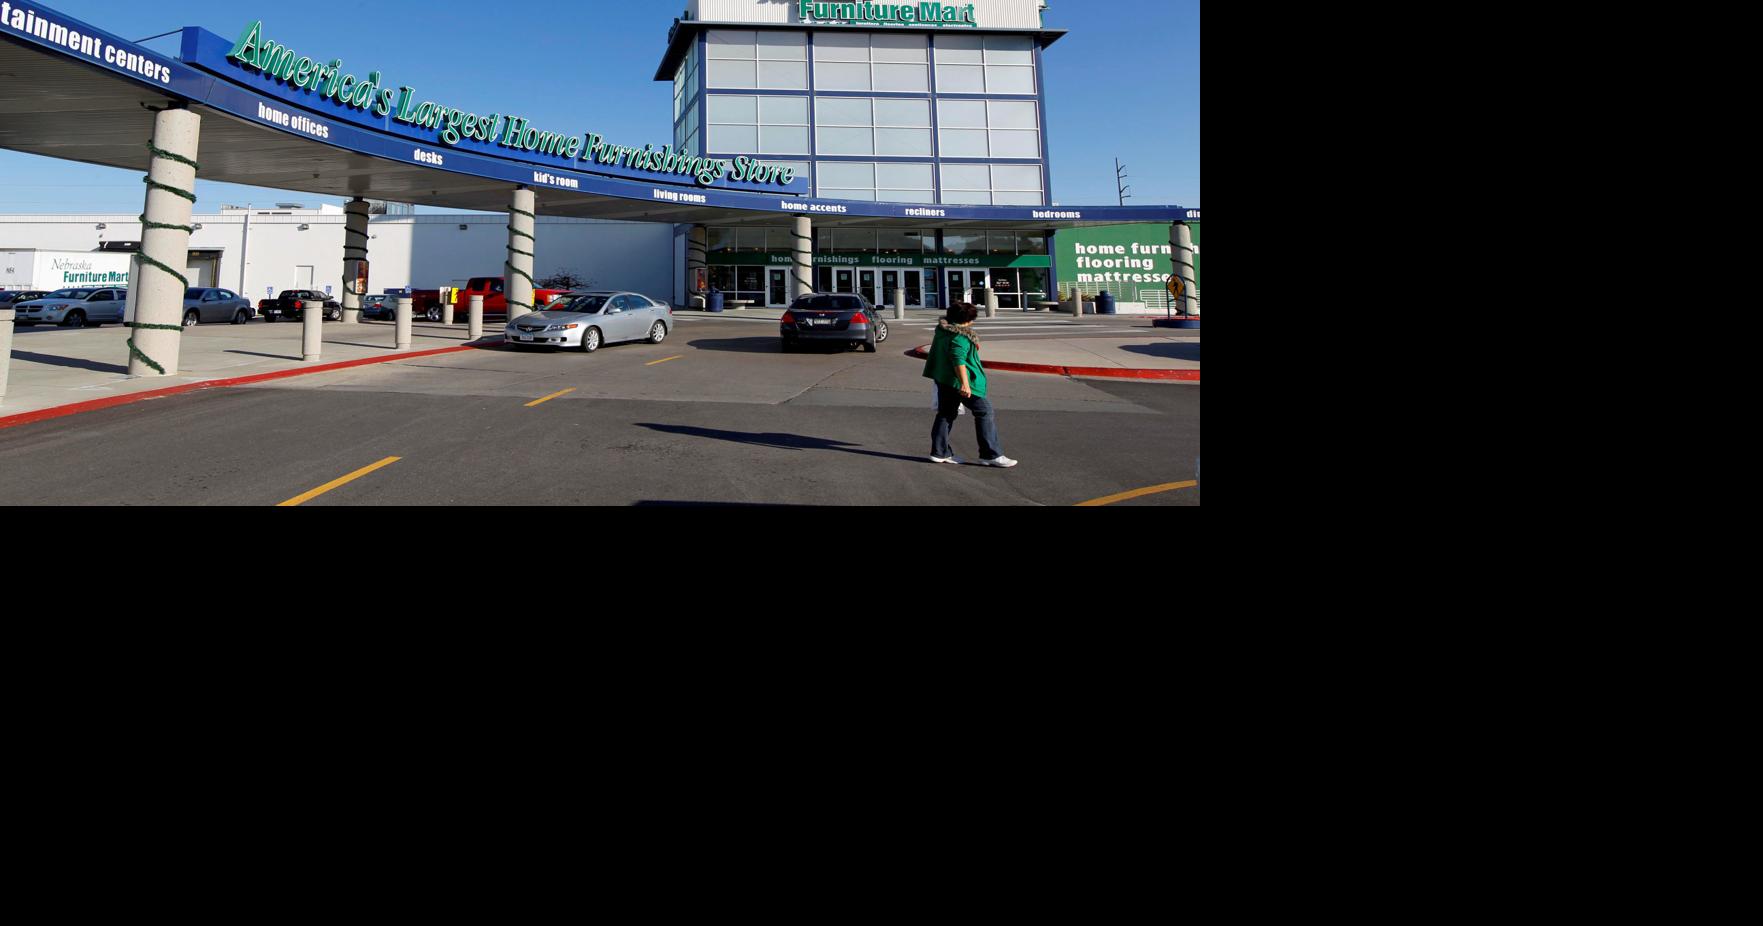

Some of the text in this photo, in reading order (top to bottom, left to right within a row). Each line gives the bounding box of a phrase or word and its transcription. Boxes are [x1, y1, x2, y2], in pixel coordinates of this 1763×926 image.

[799, 0, 976, 22] Furniture Mart
[1, 1, 170, 84] tainment centers
[230, 20, 796, 185] America's Largest Home Furnishings Store
[258, 101, 329, 138] home offices
[414, 148, 443, 165] desks
[533, 171, 579, 188] kid's room
[653, 188, 706, 203] living rooms
[781, 200, 847, 213] home accents
[905, 207, 946, 217] recliners
[1032, 210, 1081, 219] bedrooms
[1075, 242, 1200, 255] home furnh
[51, 257, 92, 270] Nebraska
[771, 255, 980, 265] hom rnishings flooring mattresses
[1076, 256, 1154, 271] flooring
[63, 270, 129, 283] Furniture Mart
[1077, 272, 1172, 283] mattresse
